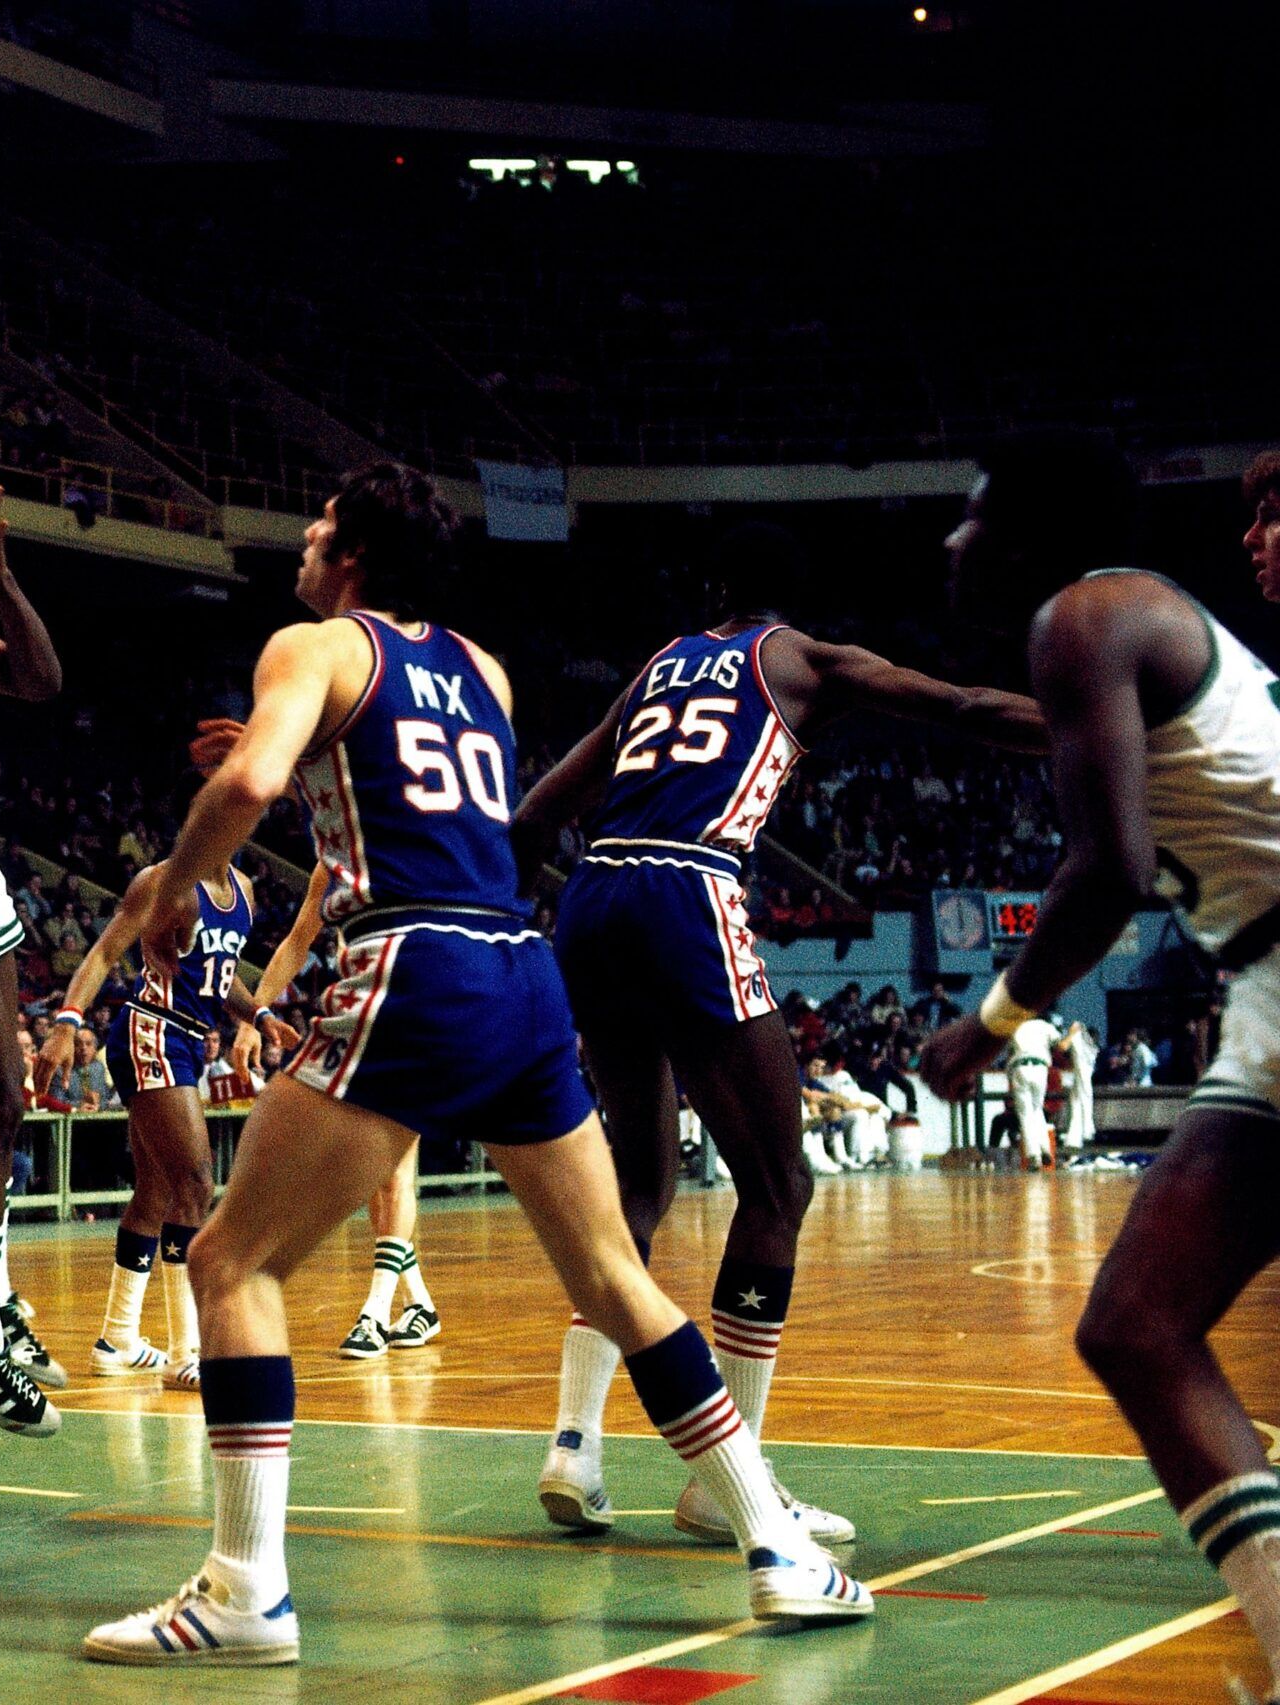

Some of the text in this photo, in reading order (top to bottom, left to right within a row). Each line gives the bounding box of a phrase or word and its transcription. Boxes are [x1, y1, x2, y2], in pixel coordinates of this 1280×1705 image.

[613, 696, 740, 779] 25
[394, 716, 510, 825] 50
[198, 955, 236, 999] 18
[143, 1060, 161, 1079] 76
[309, 1035, 348, 1071] 76
